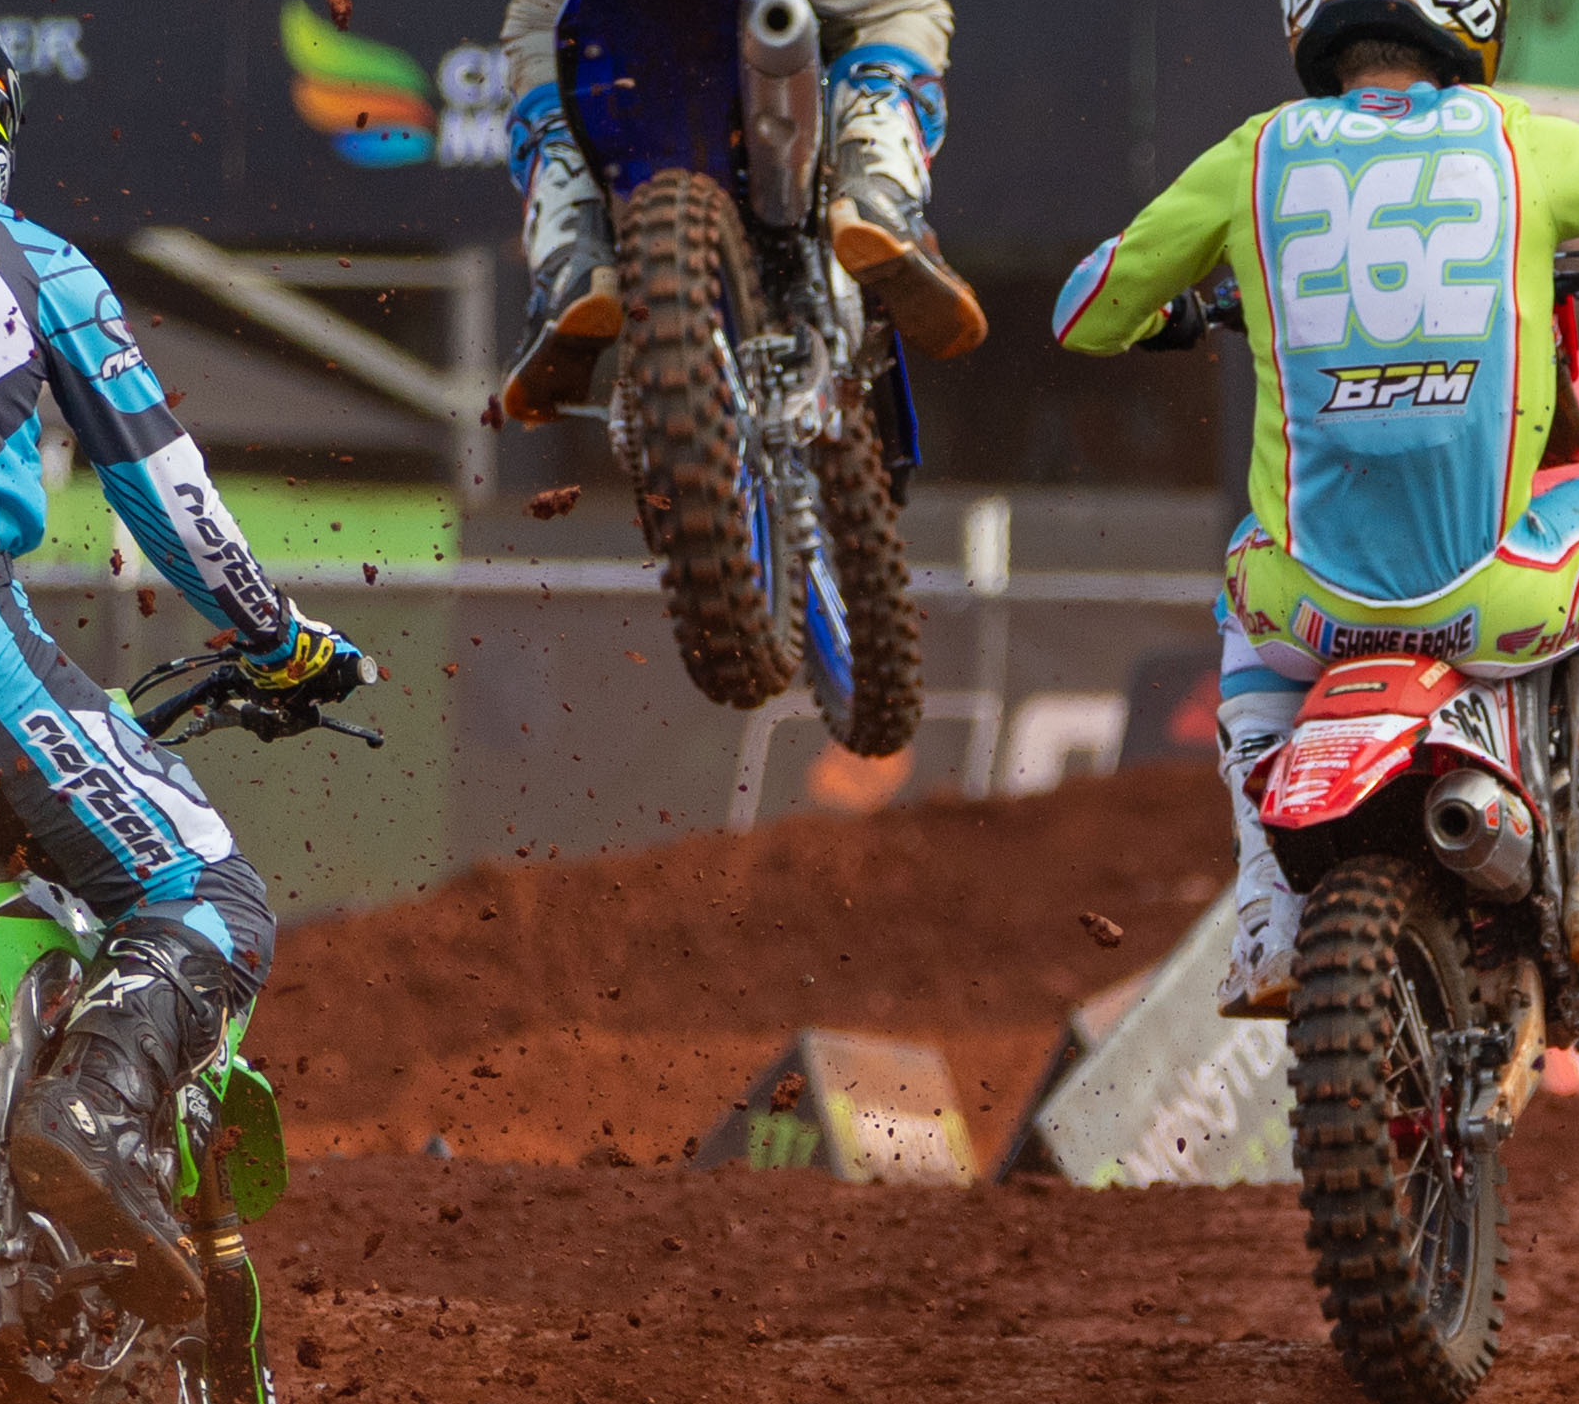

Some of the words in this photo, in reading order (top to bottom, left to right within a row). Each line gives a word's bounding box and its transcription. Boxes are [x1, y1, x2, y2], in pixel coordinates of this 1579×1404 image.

[1279, 94, 1484, 145] WOOD
[1275, 150, 1505, 355] 262
[1319, 360, 1480, 412] BPM
[1331, 625, 1402, 658] SHAKE
